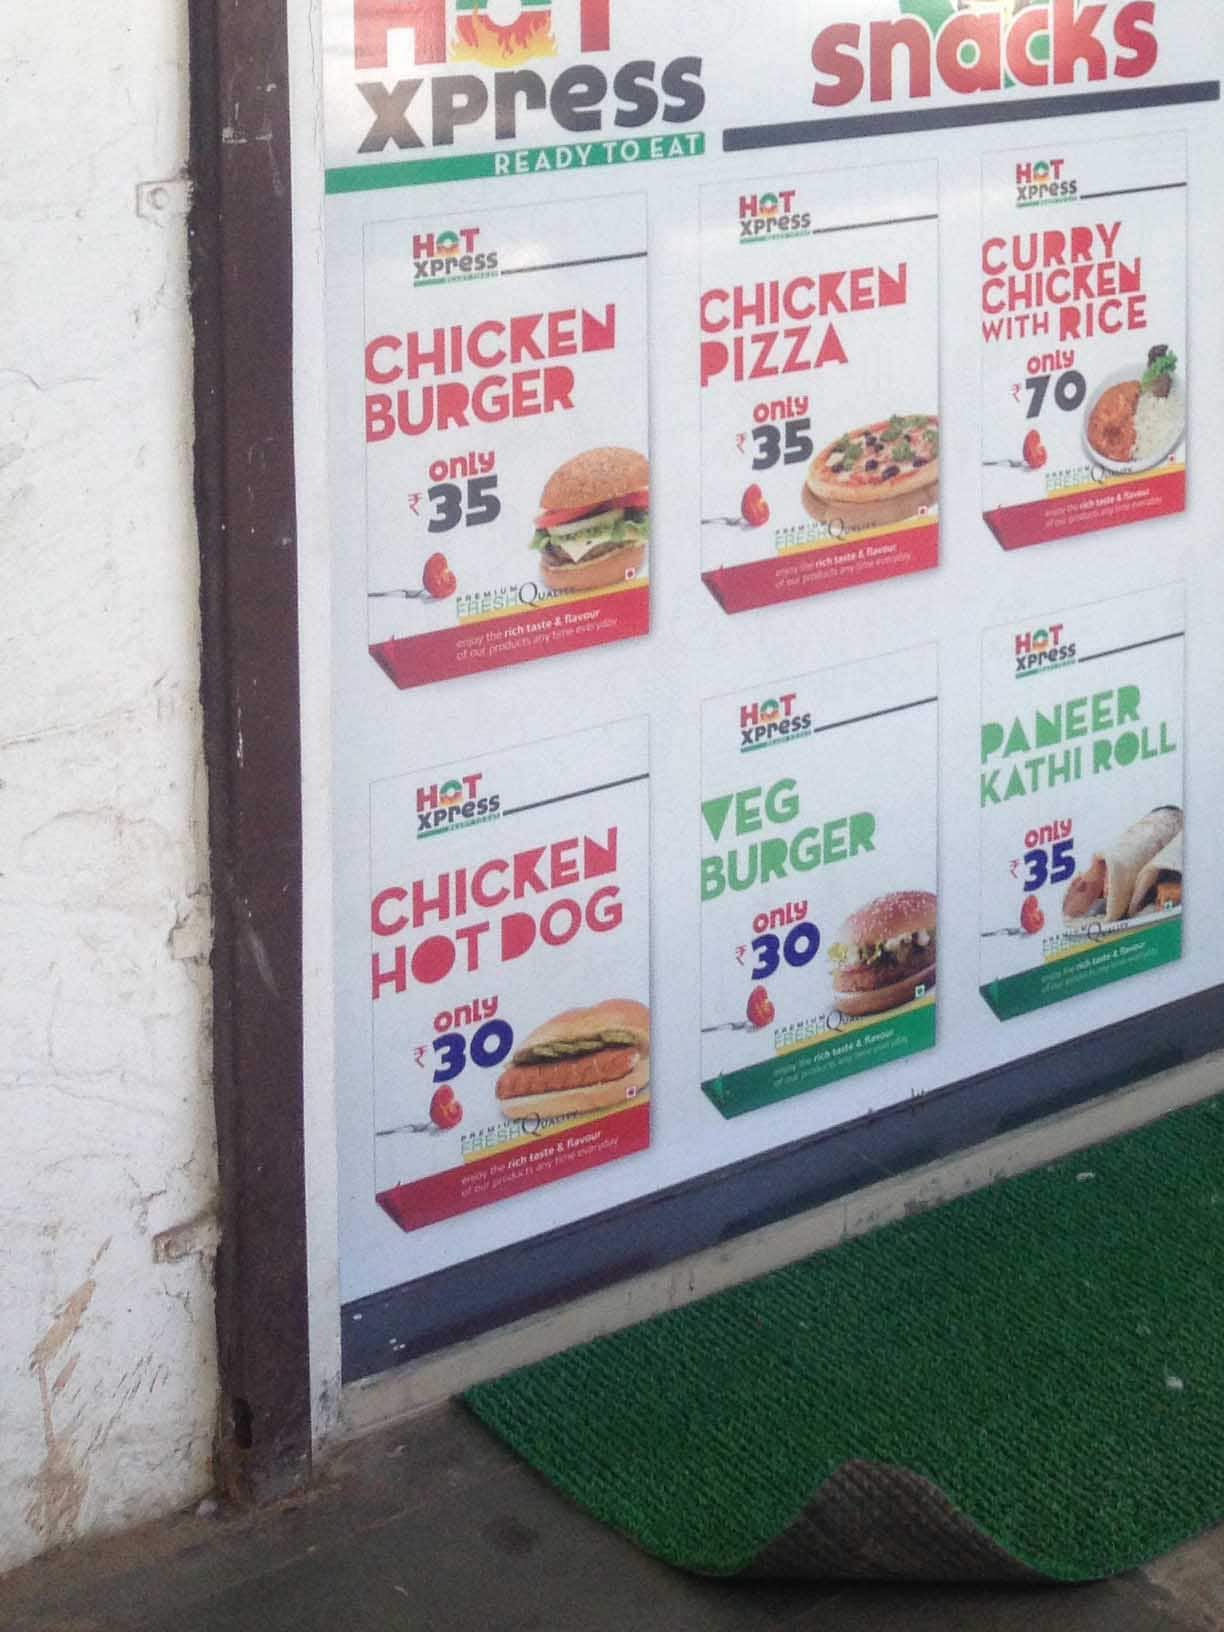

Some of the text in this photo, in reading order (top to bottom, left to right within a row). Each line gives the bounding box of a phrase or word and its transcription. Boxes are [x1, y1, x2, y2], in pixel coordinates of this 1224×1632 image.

[492, 133, 701, 177] READY TO EAT
[1015, 158, 1065, 185] HOT
[738, 189, 796, 220] HOT
[412, 227, 481, 260] HOT
[981, 221, 1123, 277] CURRY
[699, 262, 908, 335] CHICKEN
[981, 256, 1142, 315] CHICKEN
[363, 303, 617, 386] CHICKEN
[981, 294, 1148, 345] WITH RICE
[699, 321, 850, 389] PIZZA
[1026, 348, 1075, 377] only
[364, 365, 576, 443] BURGER
[752, 394, 810, 424] only
[1023, 369, 1087, 420] 70
[427, 449, 497, 483] only
[751, 417, 814, 471] 35
[426, 473, 502, 534] 35
[1015, 623, 1063, 657] HOT
[740, 692, 797, 729] HOT
[980, 684, 1142, 766] PANEER
[416, 771, 483, 813] HOT
[980, 721, 1177, 809] KATHI ROLL
[700, 777, 800, 842] VEG
[1024, 817, 1074, 850] only
[370, 825, 619, 937] CHICKEN
[700, 811, 877, 902] BURGER
[1022, 838, 1077, 893] 35
[371, 885, 624, 1001] HOT DOG
[751, 899, 809, 934] only
[751, 921, 821, 981] 30
[432, 994, 499, 1033] only
[432, 1017, 515, 1084] 30
